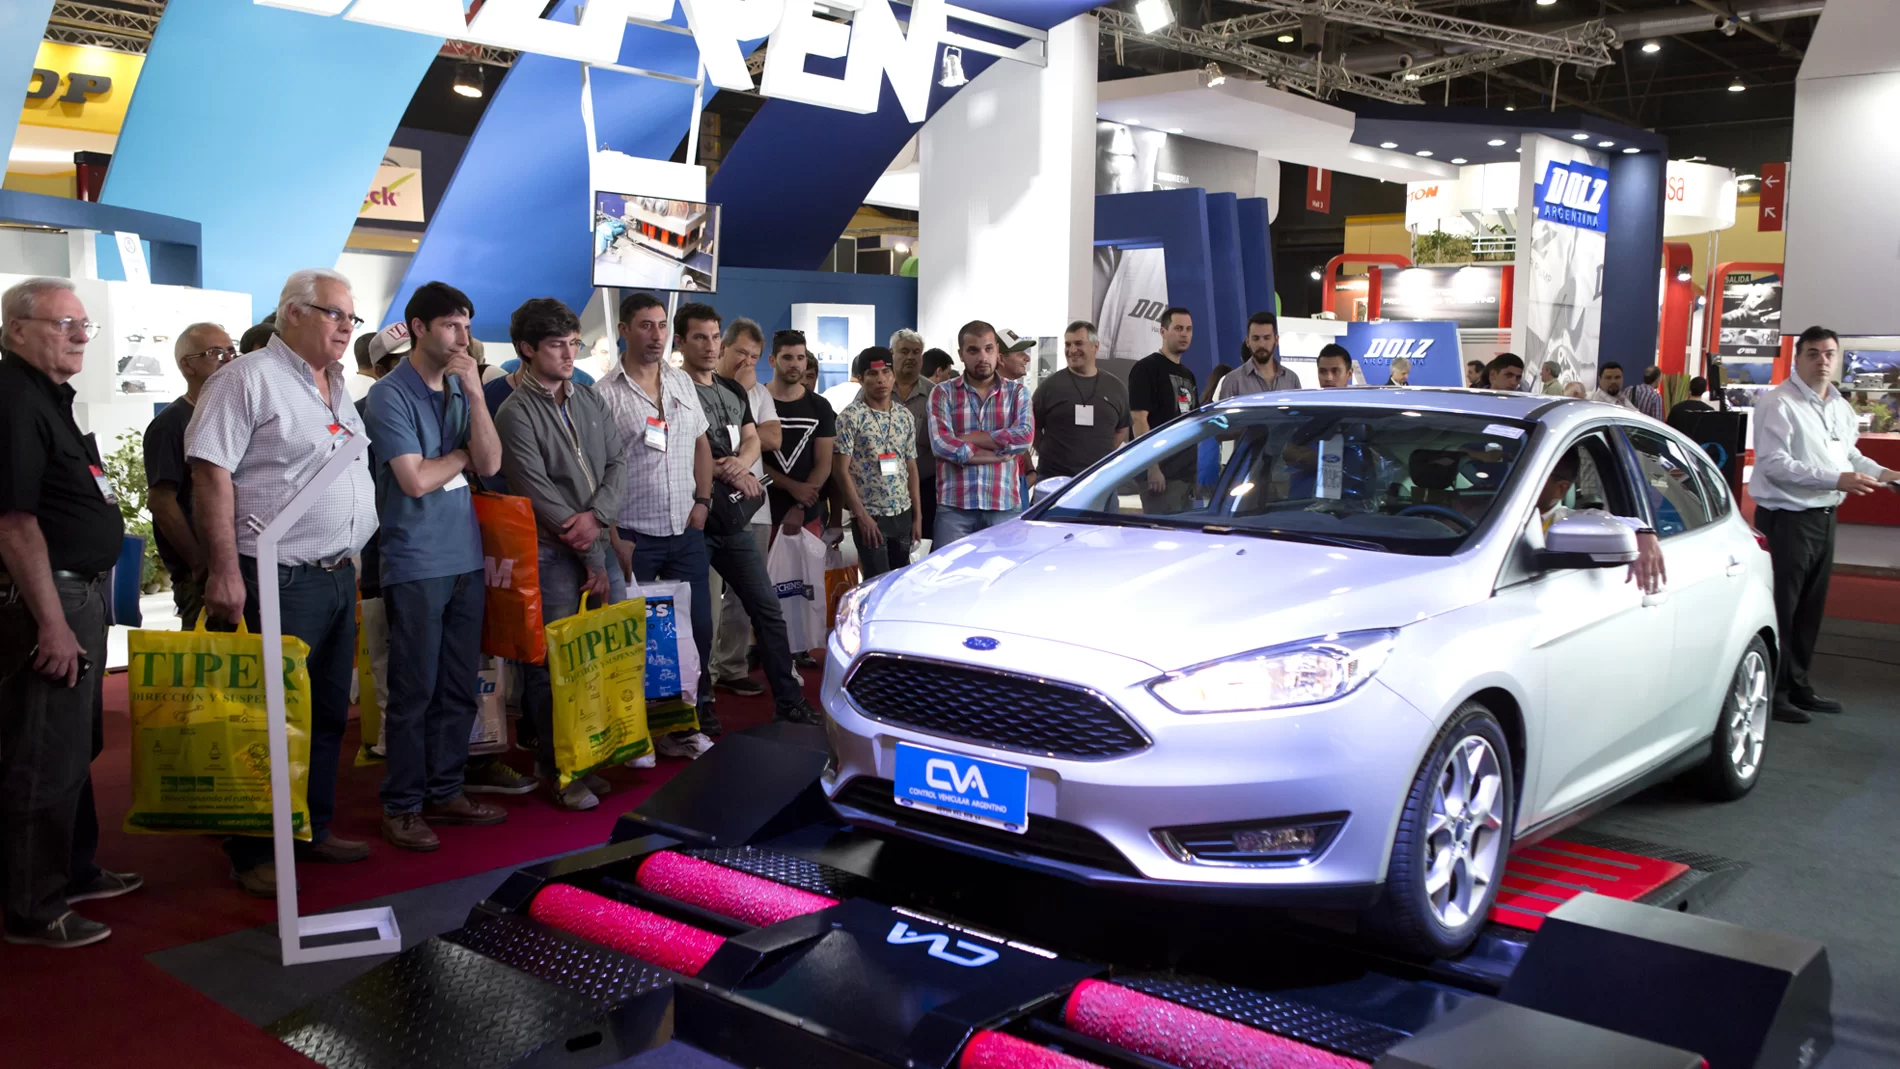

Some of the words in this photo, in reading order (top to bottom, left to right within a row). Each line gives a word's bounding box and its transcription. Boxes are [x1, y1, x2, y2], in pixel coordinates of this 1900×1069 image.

[364, 186, 397, 206] ck
[1544, 166, 1608, 213] DOLZ
[1544, 204, 1599, 227] ARGENTINA
[1725, 274, 1750, 283] SALIDA
[1128, 298, 1168, 324] DO
[1362, 357, 1425, 366] ARGENA
[1363, 338, 1434, 359] DOLZ
[560, 617, 643, 673] TIPER
[132, 652, 300, 691] TIPER
[926, 758, 989, 798] CVA
[909, 786, 937, 799] CONTROL
[938, 791, 971, 807] VEHICULAR
[971, 799, 1008, 814] ARGENTINO
